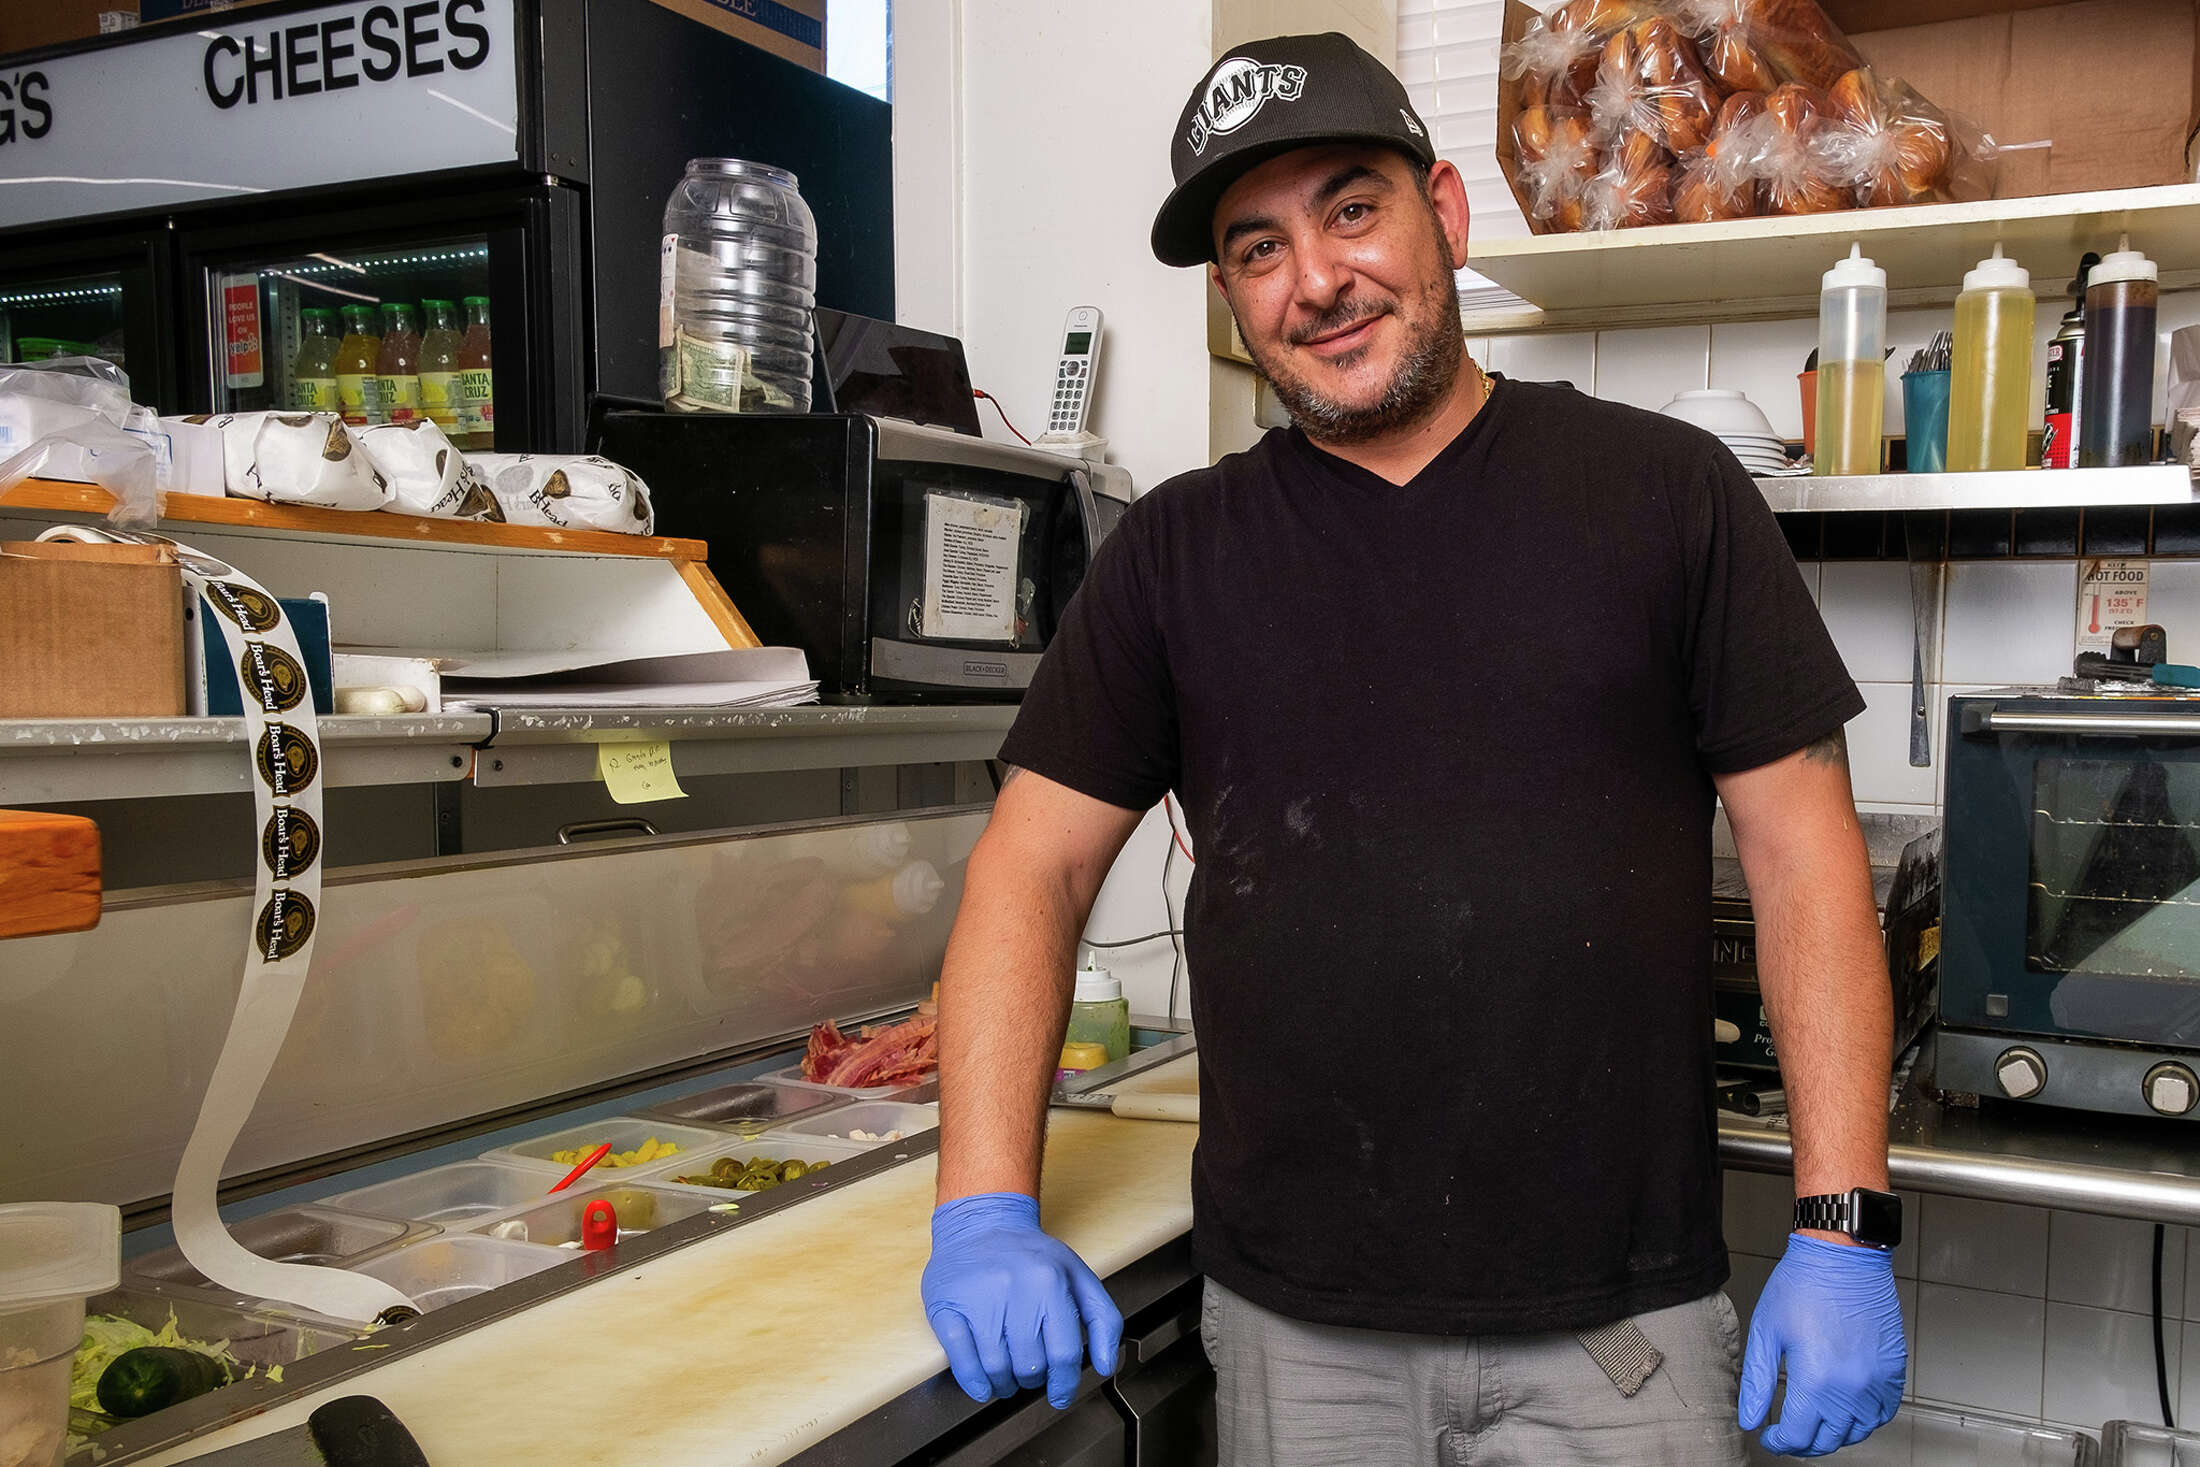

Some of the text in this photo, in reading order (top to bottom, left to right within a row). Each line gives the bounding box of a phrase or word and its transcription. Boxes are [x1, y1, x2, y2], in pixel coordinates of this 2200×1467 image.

[204, 0, 490, 109] CHEESES
[1188, 63, 1308, 156] GIANTS
[247, 312, 256, 320] US
[464, 385, 488, 398] CRUZ
[2086, 570, 2144, 581] HOT FOOD
[232, 602, 257, 631] Head
[250, 643, 279, 711] Boar's Head
[268, 724, 288, 794] Boar's Head
[276, 808, 290, 878] Boar's Head
[267, 892, 287, 959] Boar's Head
